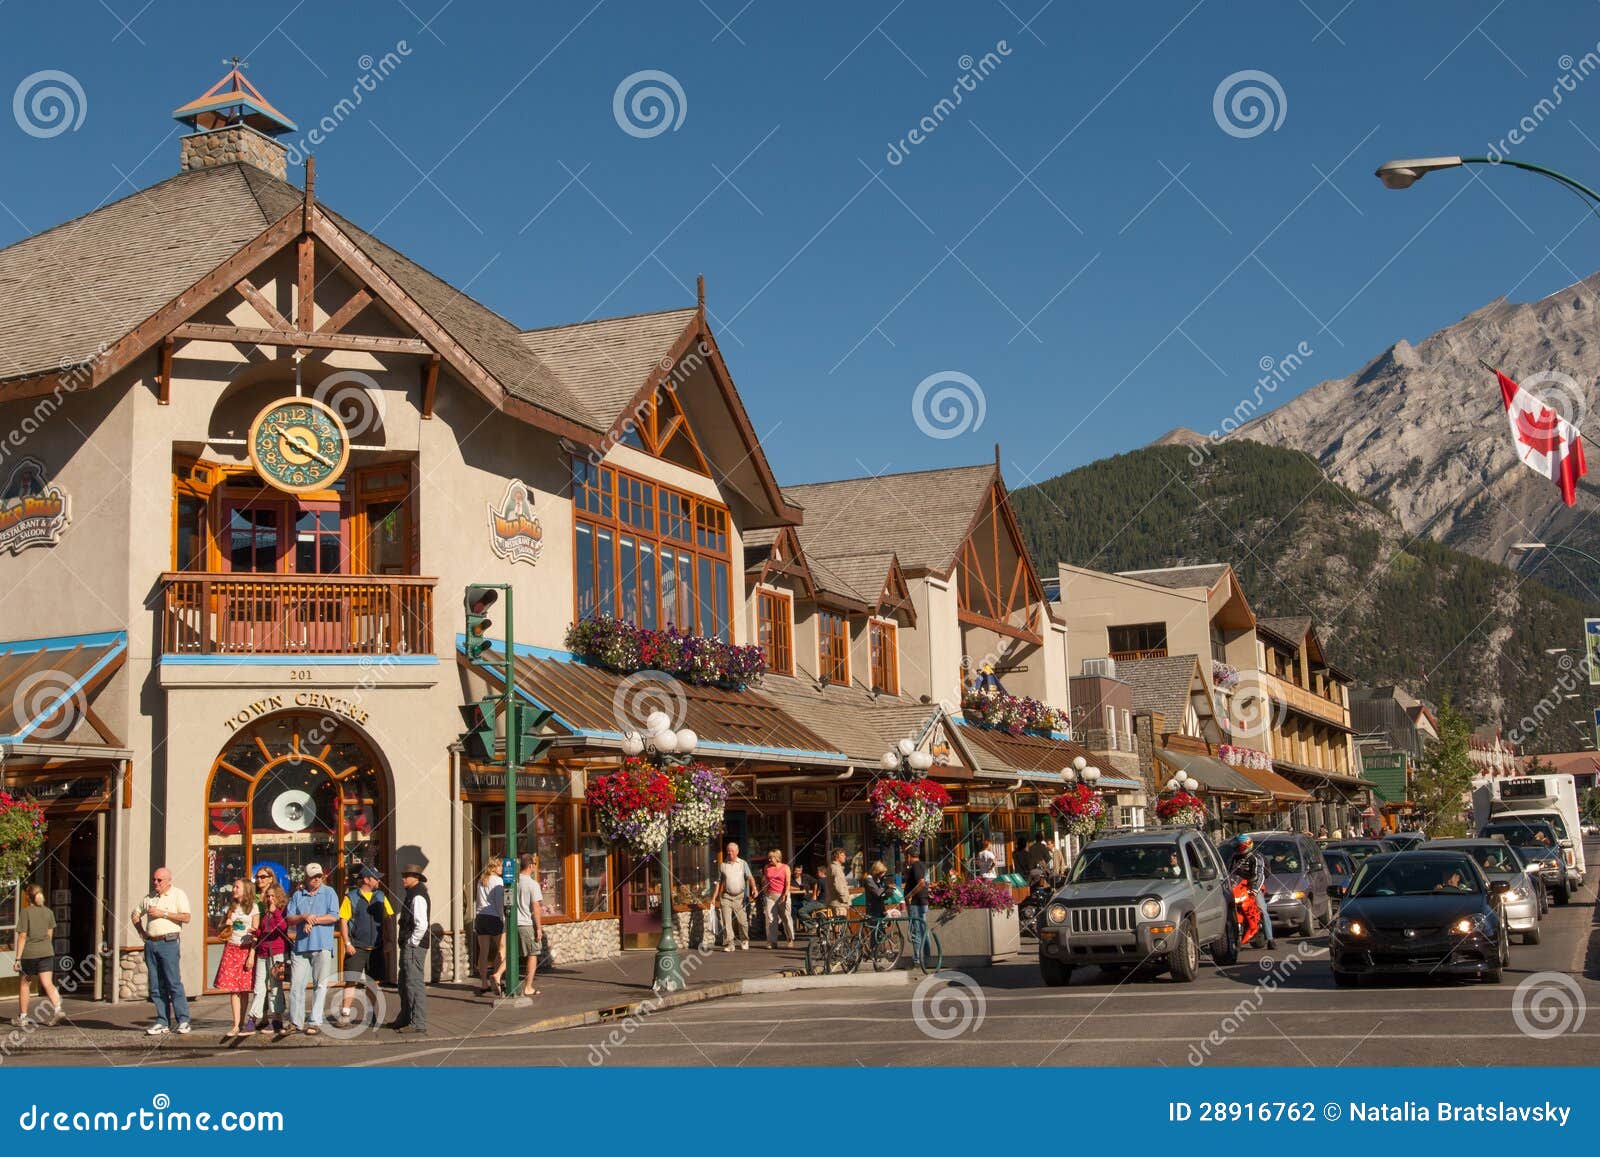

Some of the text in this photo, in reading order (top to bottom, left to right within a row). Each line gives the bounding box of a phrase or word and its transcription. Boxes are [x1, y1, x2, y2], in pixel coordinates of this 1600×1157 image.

[279, 411, 289, 424] 11
[291, 408, 306, 420] 12
[312, 413, 318, 424] 1
[264, 423, 278, 434] 10
[321, 425, 331, 436] 2
[262, 438, 273, 449] 9
[325, 440, 335, 453] 3
[266, 452, 276, 463] 8
[277, 463, 289, 475] 7
[310, 465, 320, 477] 5
[292, 471, 304, 483] 6
[290, 669, 313, 681] 201
[224, 692, 370, 732] TOWN CENTRE
